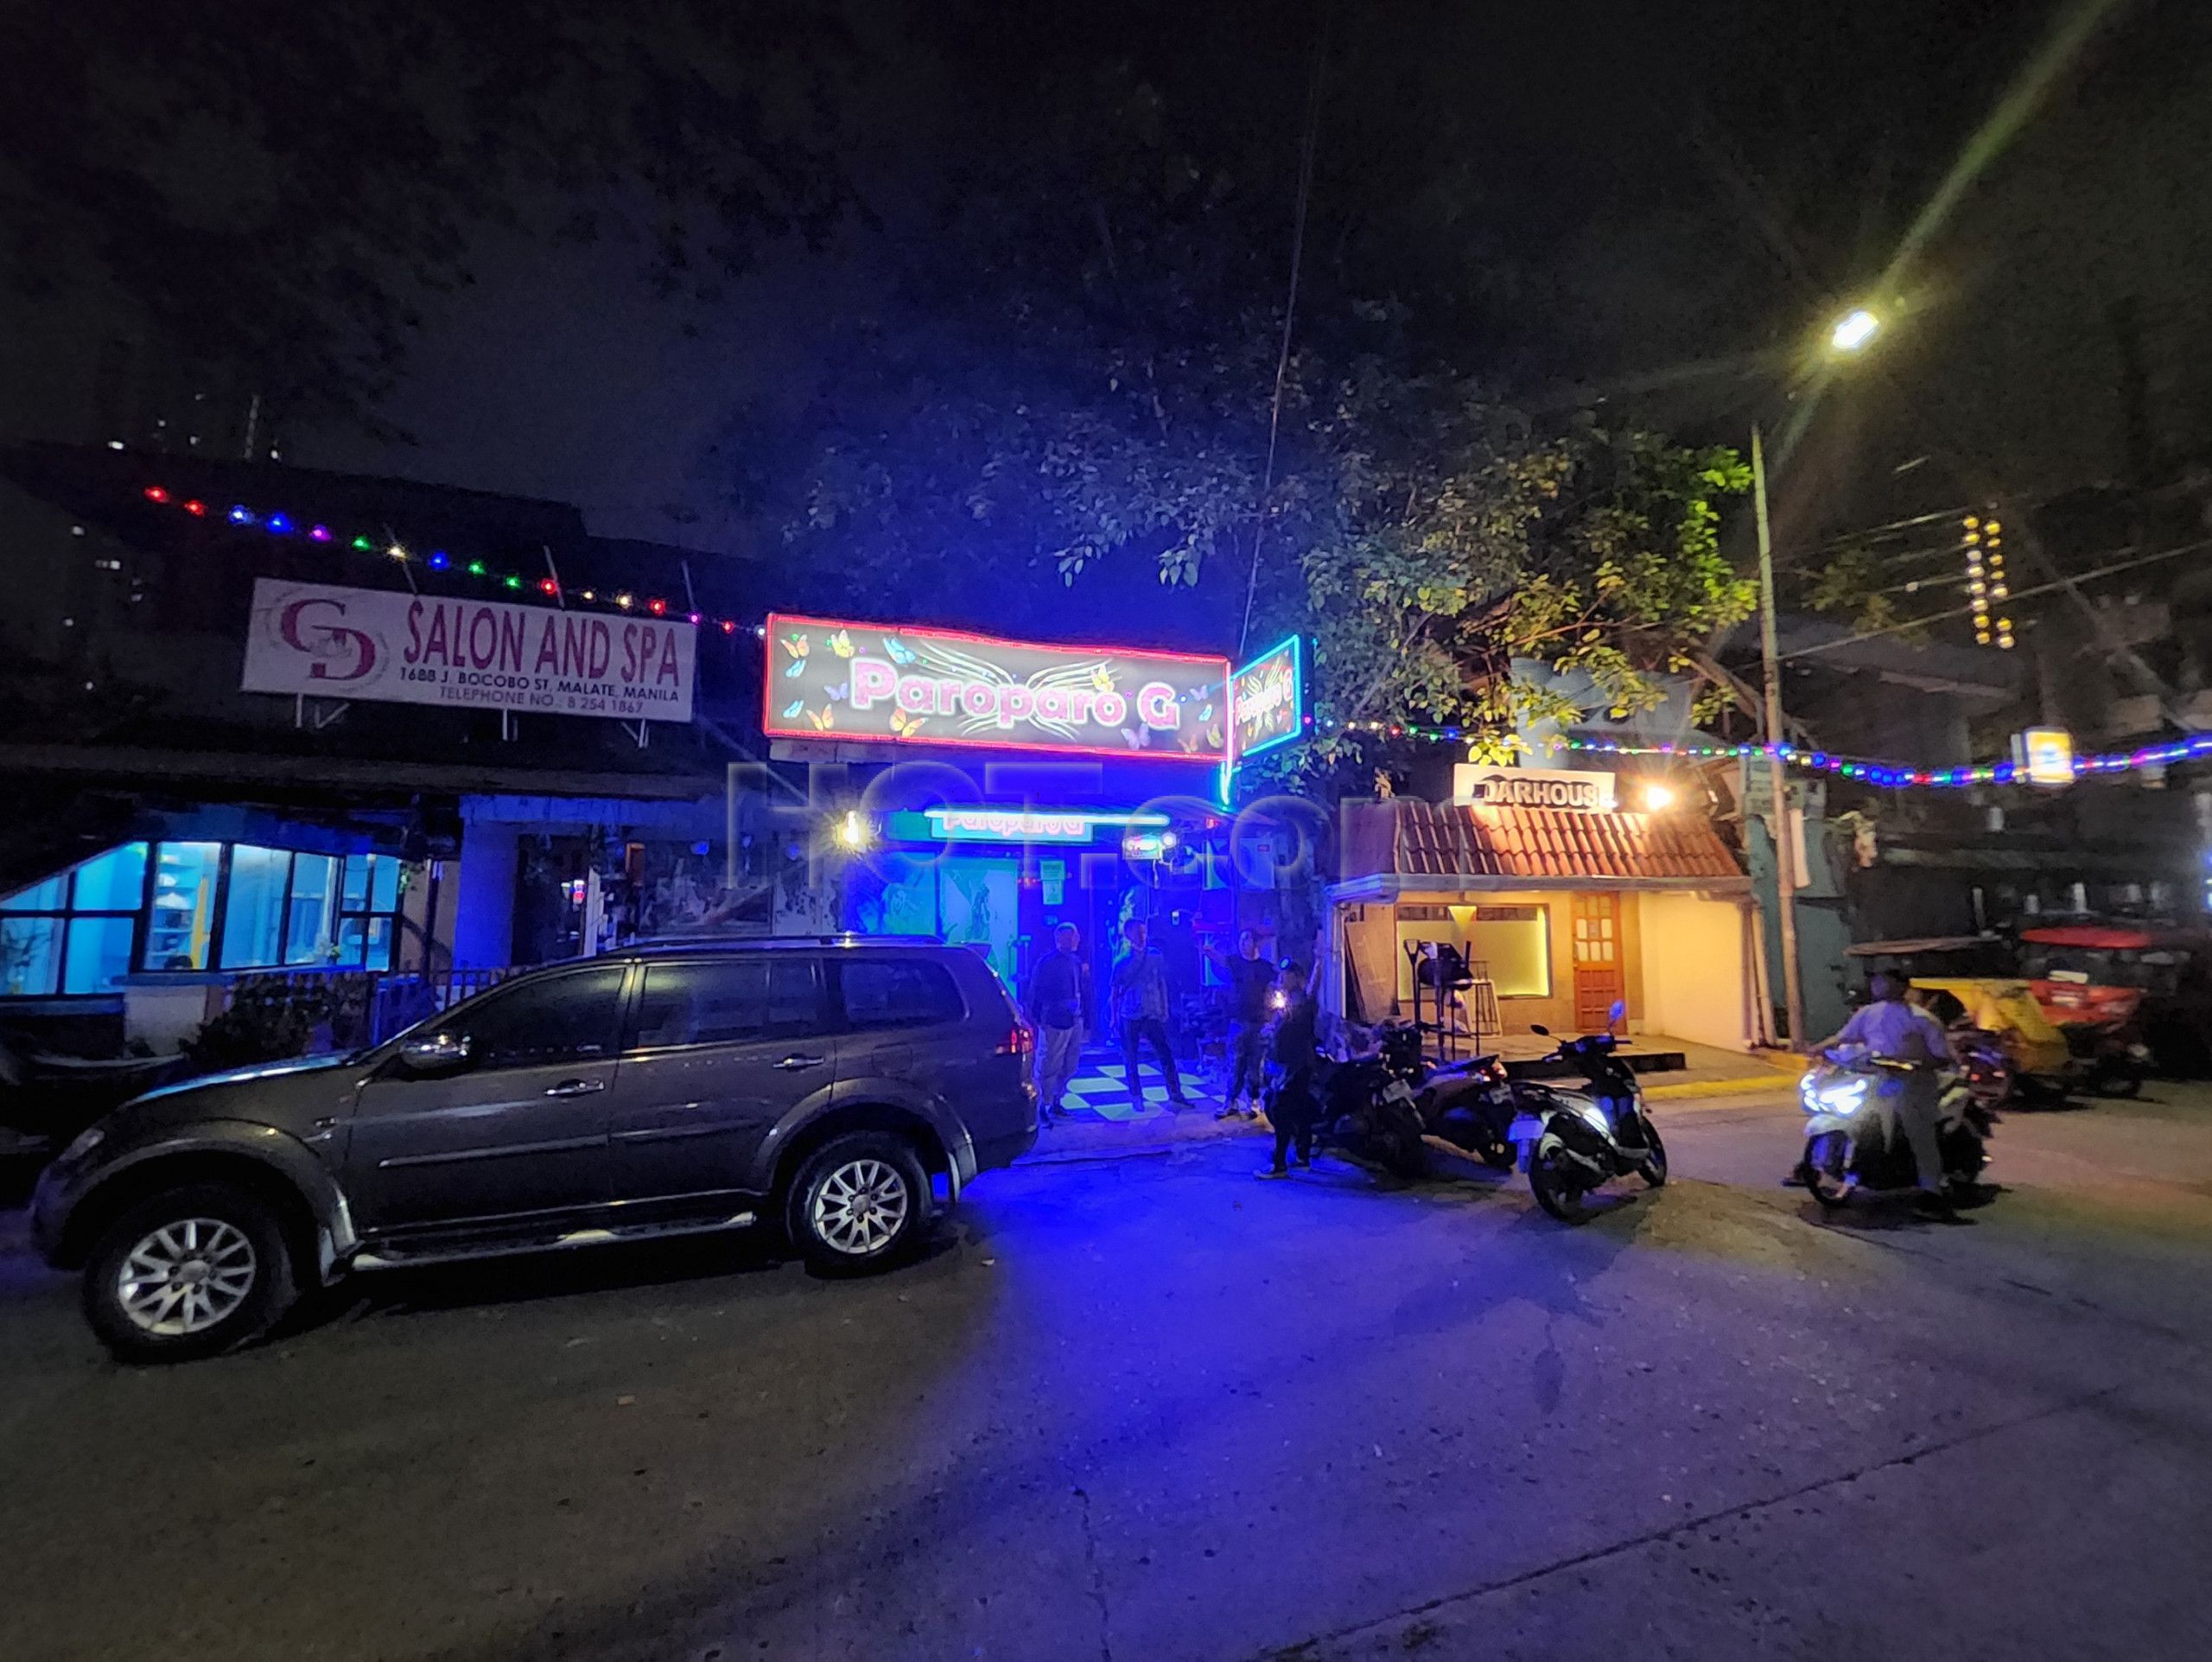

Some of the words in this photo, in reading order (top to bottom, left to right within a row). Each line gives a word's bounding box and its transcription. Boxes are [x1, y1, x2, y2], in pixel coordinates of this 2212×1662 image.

[404, 600, 525, 673] SALON
[534, 612, 611, 680] AND
[620, 622, 680, 688] SPA
[400, 667, 435, 683] 1688
[458, 672, 530, 690] BOCOBO
[623, 686, 678, 704] MANILA
[439, 685, 524, 705] TELEPHONE
[567, 696, 575, 709] 8
[579, 697, 606, 710] 254
[849, 656, 1127, 729] Paroparo
[1136, 681, 1180, 729] G
